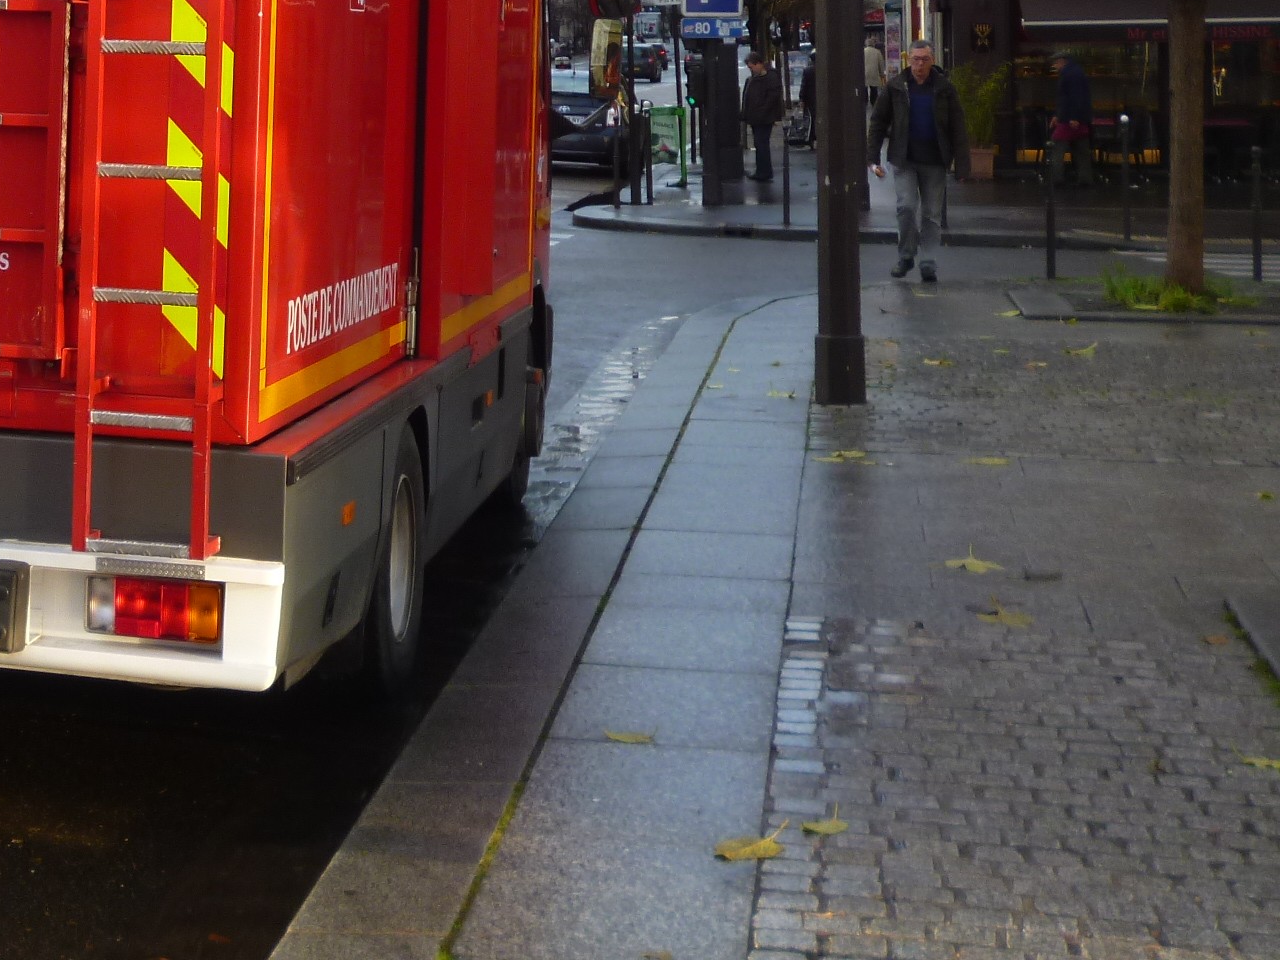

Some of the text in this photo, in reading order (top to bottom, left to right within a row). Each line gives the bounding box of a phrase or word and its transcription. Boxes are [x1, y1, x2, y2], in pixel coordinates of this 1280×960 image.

[695, 22, 711, 34] 80
[286, 262, 399, 355] POSTE DE COMMANDEMENT
